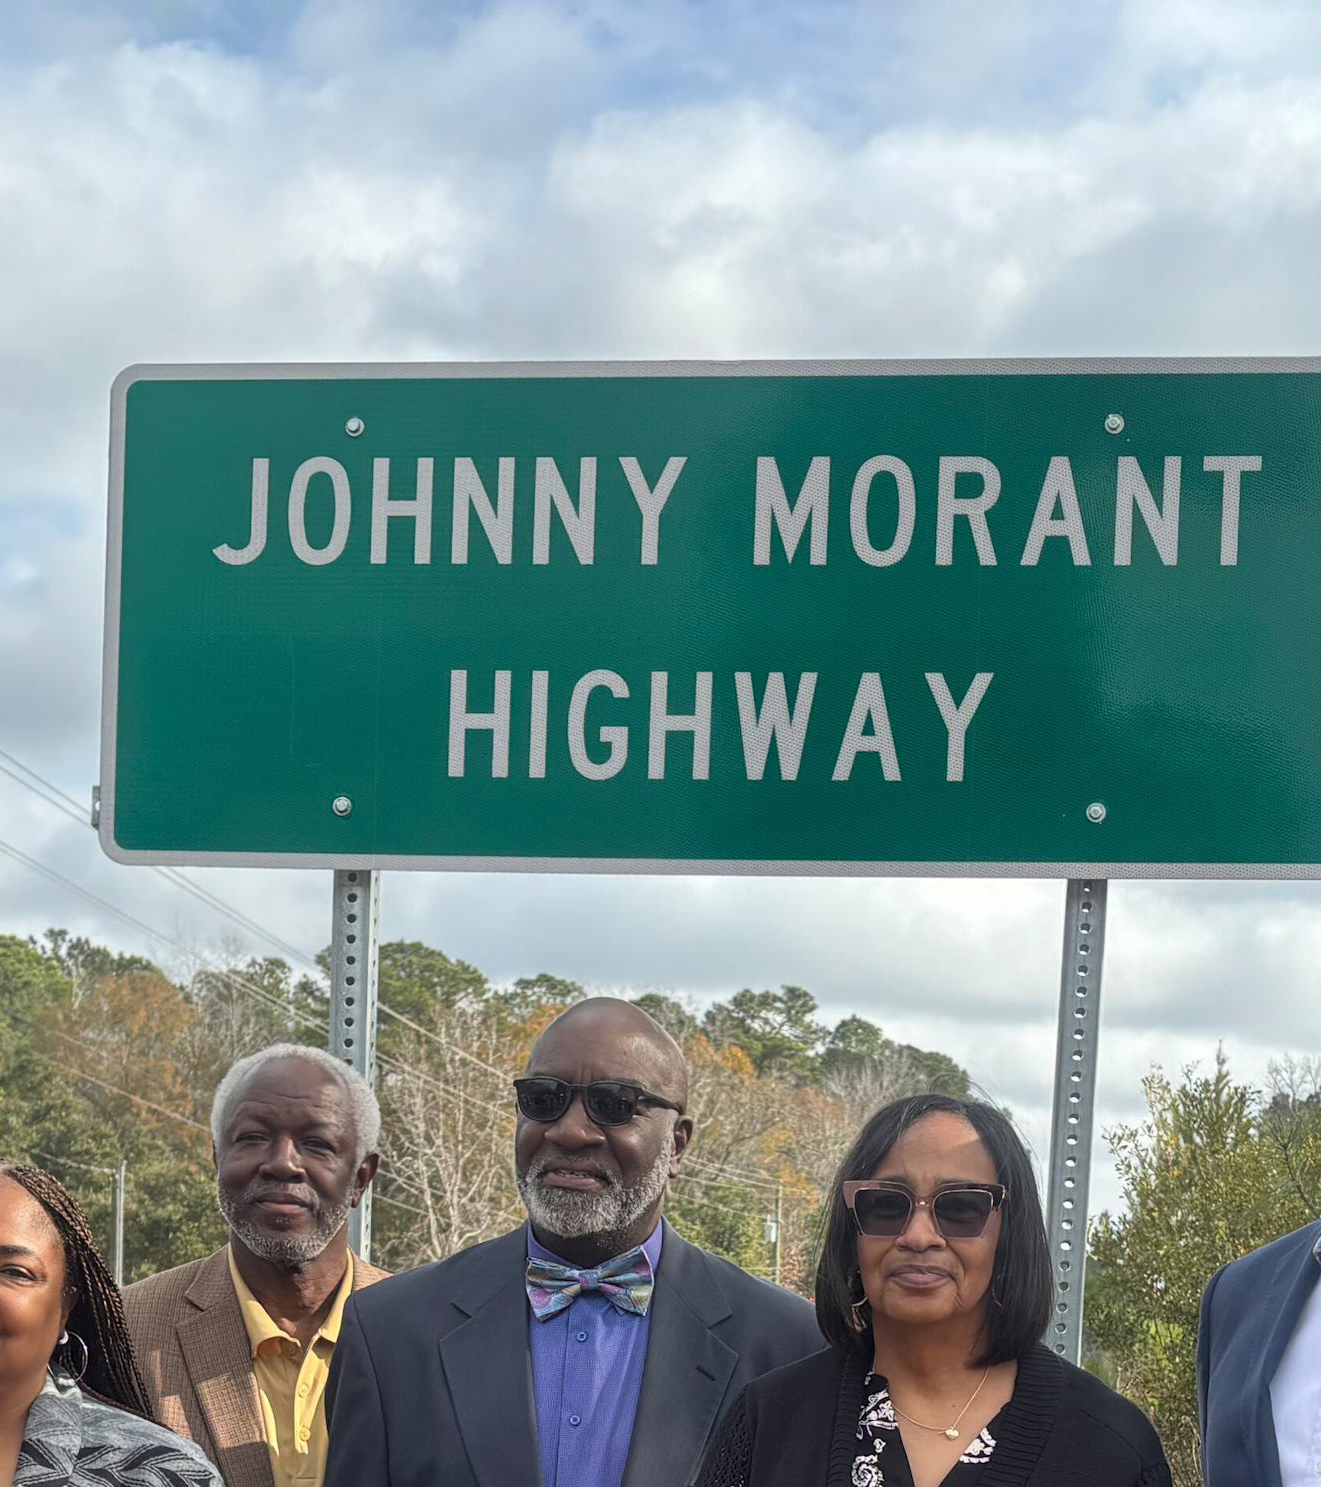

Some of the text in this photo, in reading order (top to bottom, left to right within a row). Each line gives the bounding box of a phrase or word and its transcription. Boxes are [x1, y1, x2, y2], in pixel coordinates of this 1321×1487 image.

[213, 455, 1263, 566] JOHNNY MORANT
[448, 669, 994, 782] HIGHWAY
